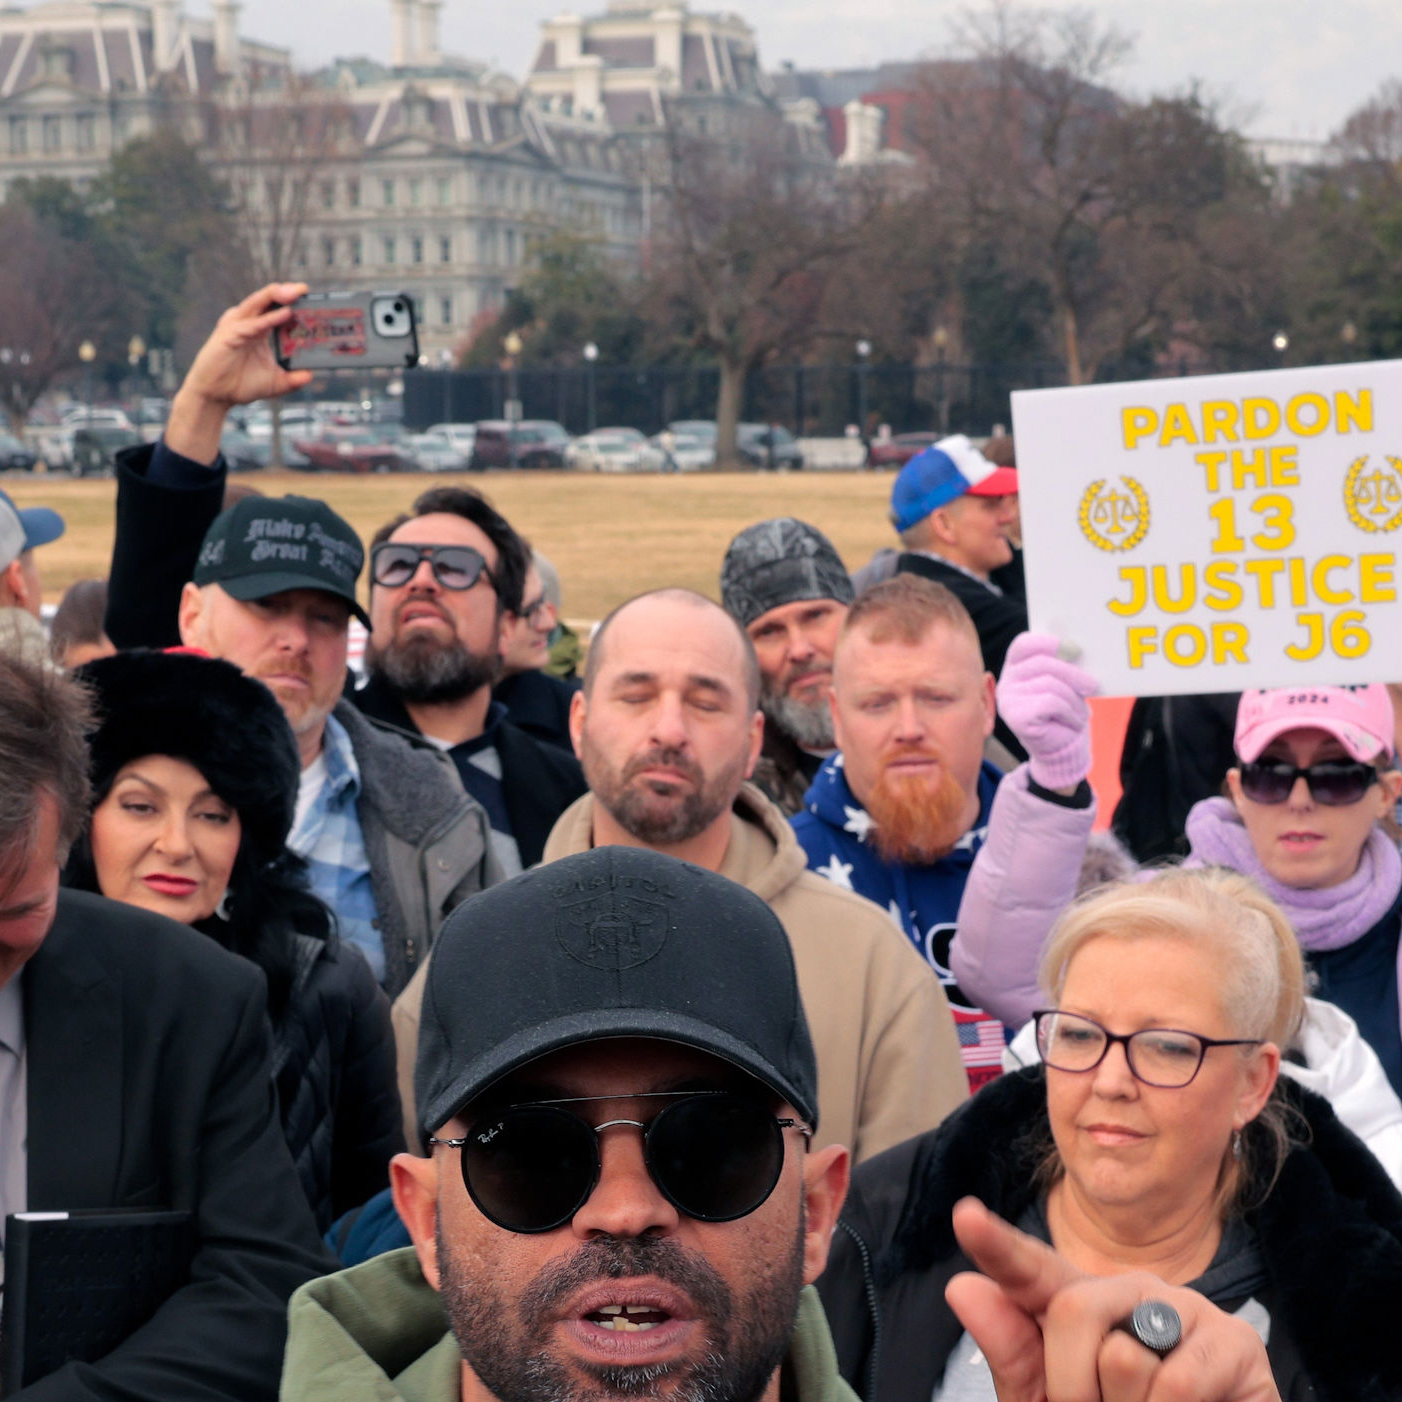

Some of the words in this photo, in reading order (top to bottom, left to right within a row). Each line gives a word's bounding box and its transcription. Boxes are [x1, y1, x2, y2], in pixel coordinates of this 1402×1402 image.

[1121, 389, 1374, 449] PARDON
[1195, 445, 1300, 492] THE
[1209, 494, 1295, 553] 13
[1107, 553, 1397, 616] JUSTICE
[1127, 622, 1249, 669] FOR
[1285, 610, 1372, 661] J6
